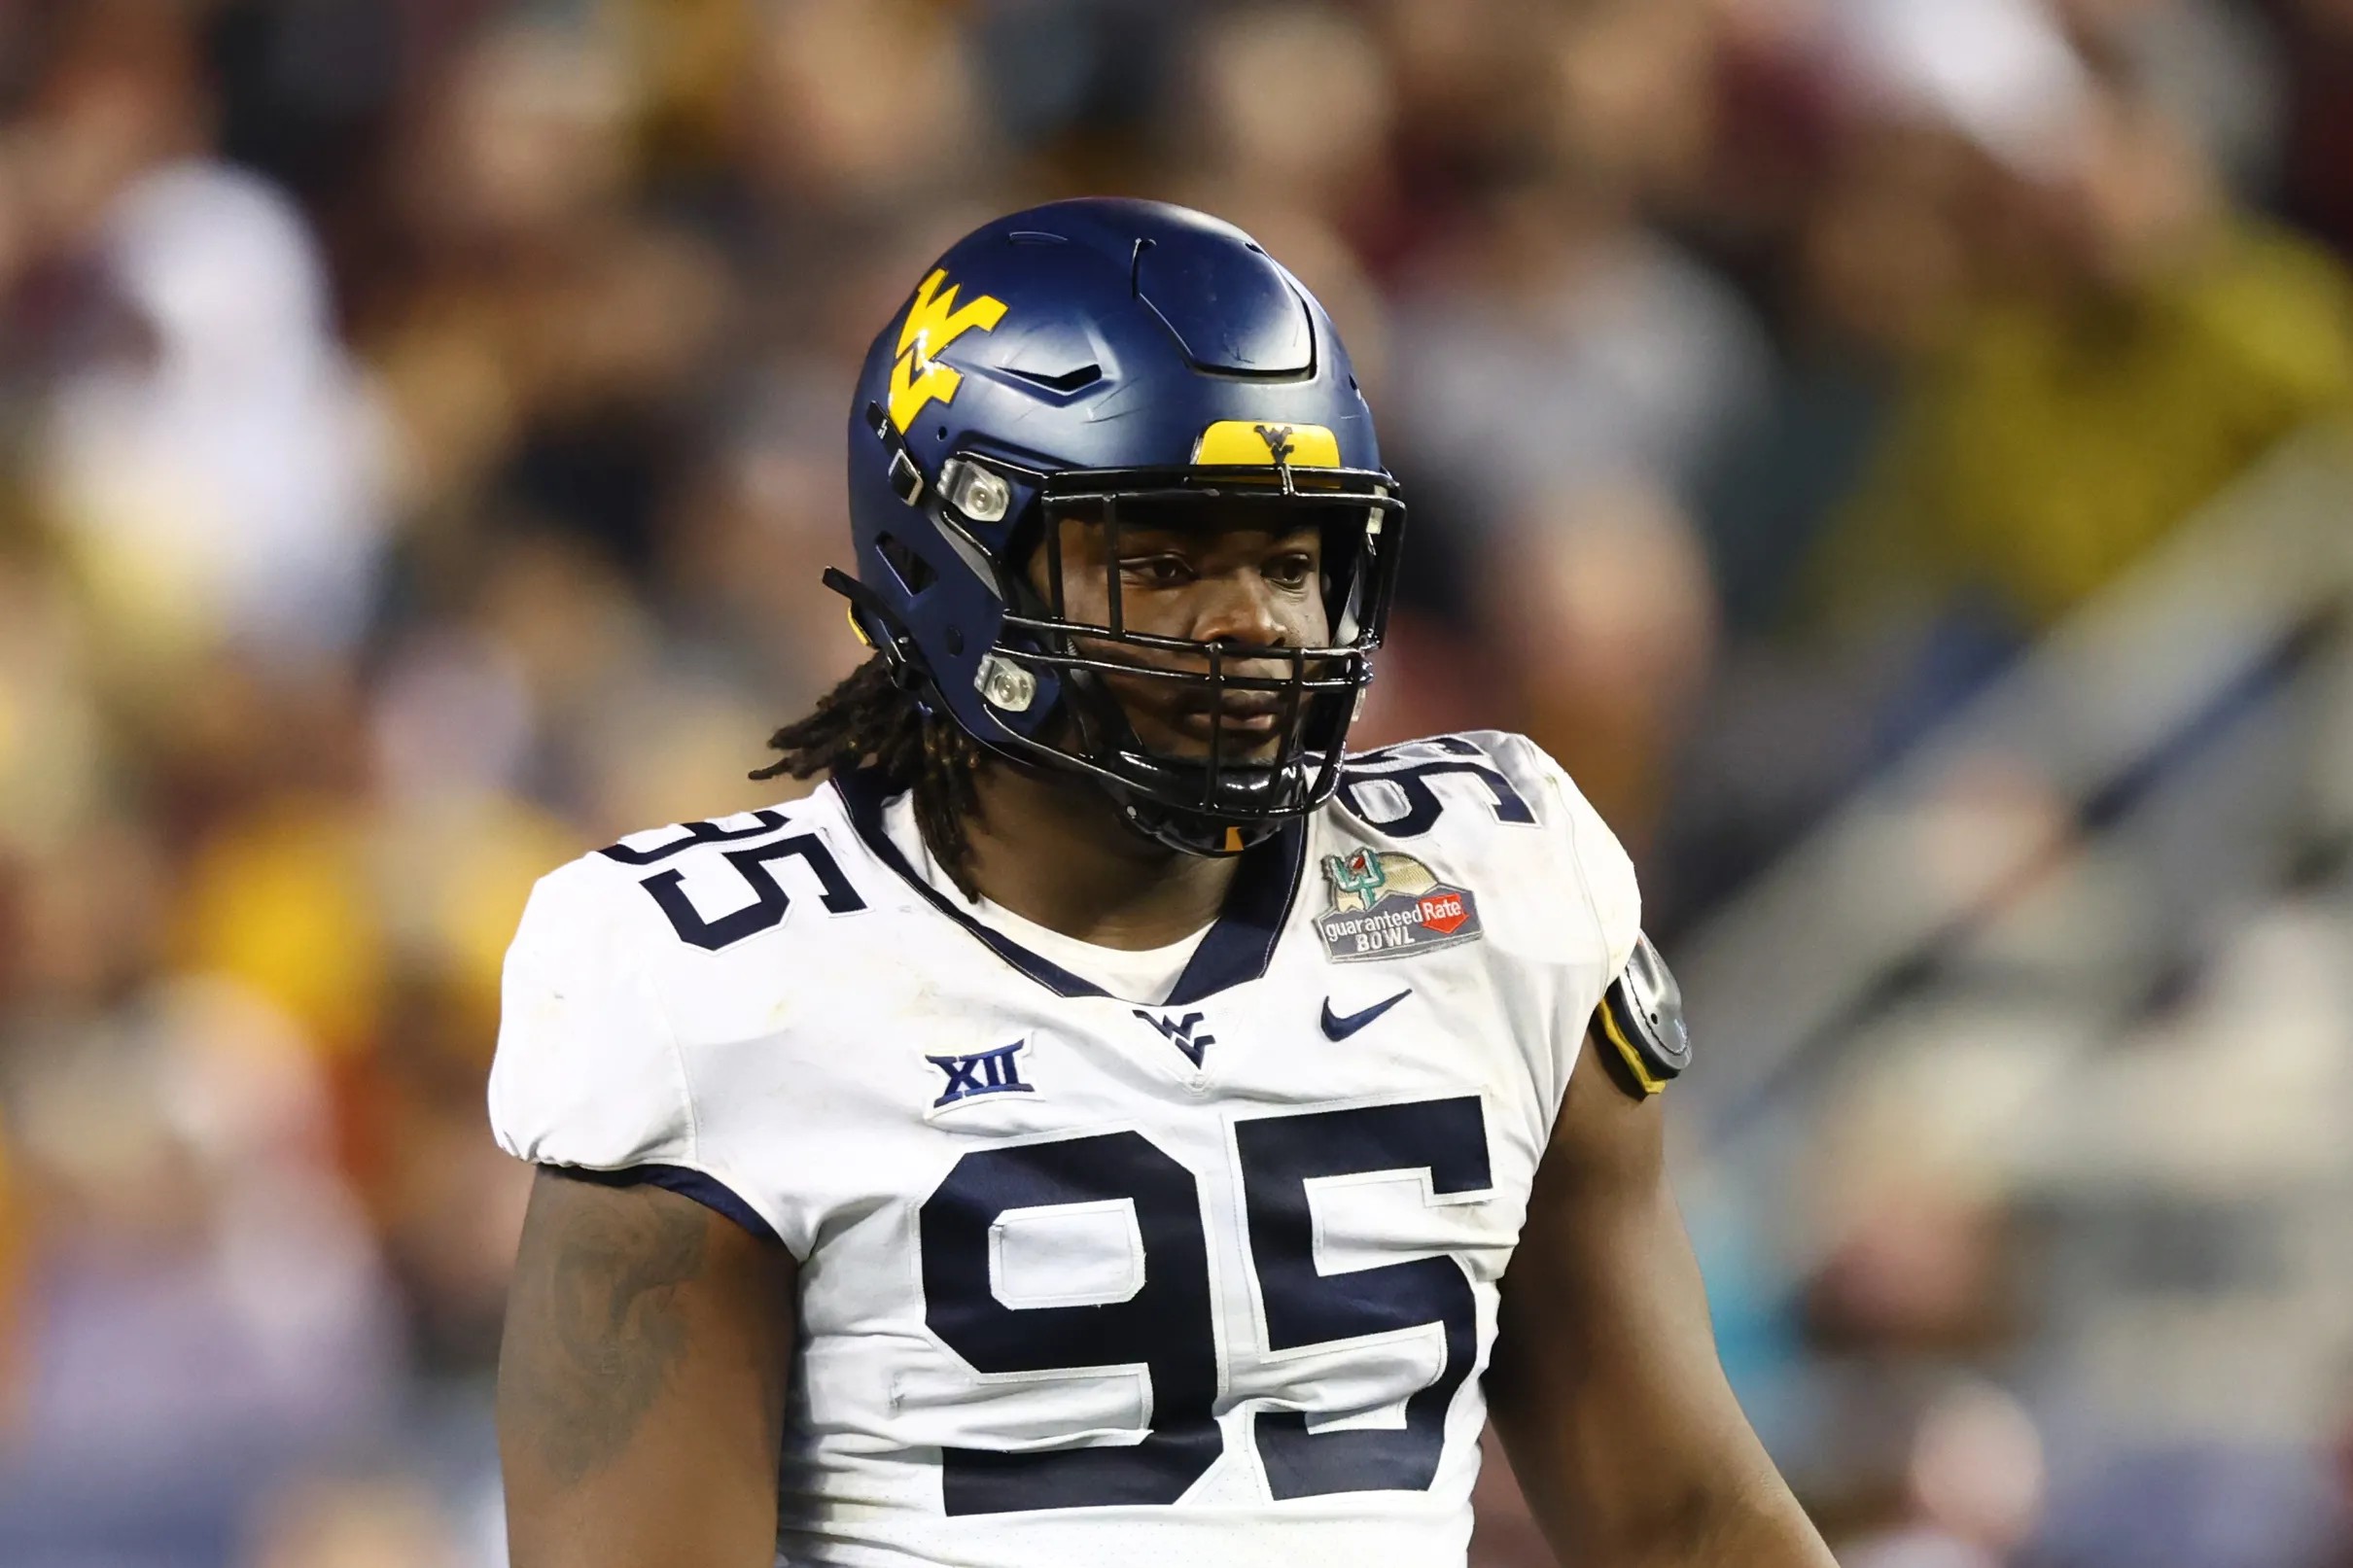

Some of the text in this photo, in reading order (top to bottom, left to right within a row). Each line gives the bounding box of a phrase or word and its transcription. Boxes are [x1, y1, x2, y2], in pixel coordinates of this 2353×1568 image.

[1325, 899, 1461, 942] guaranteed Rate
[1355, 925, 1416, 953] BOWL
[924, 1037, 1035, 1108] XII
[919, 1095, 1493, 1517] 95
